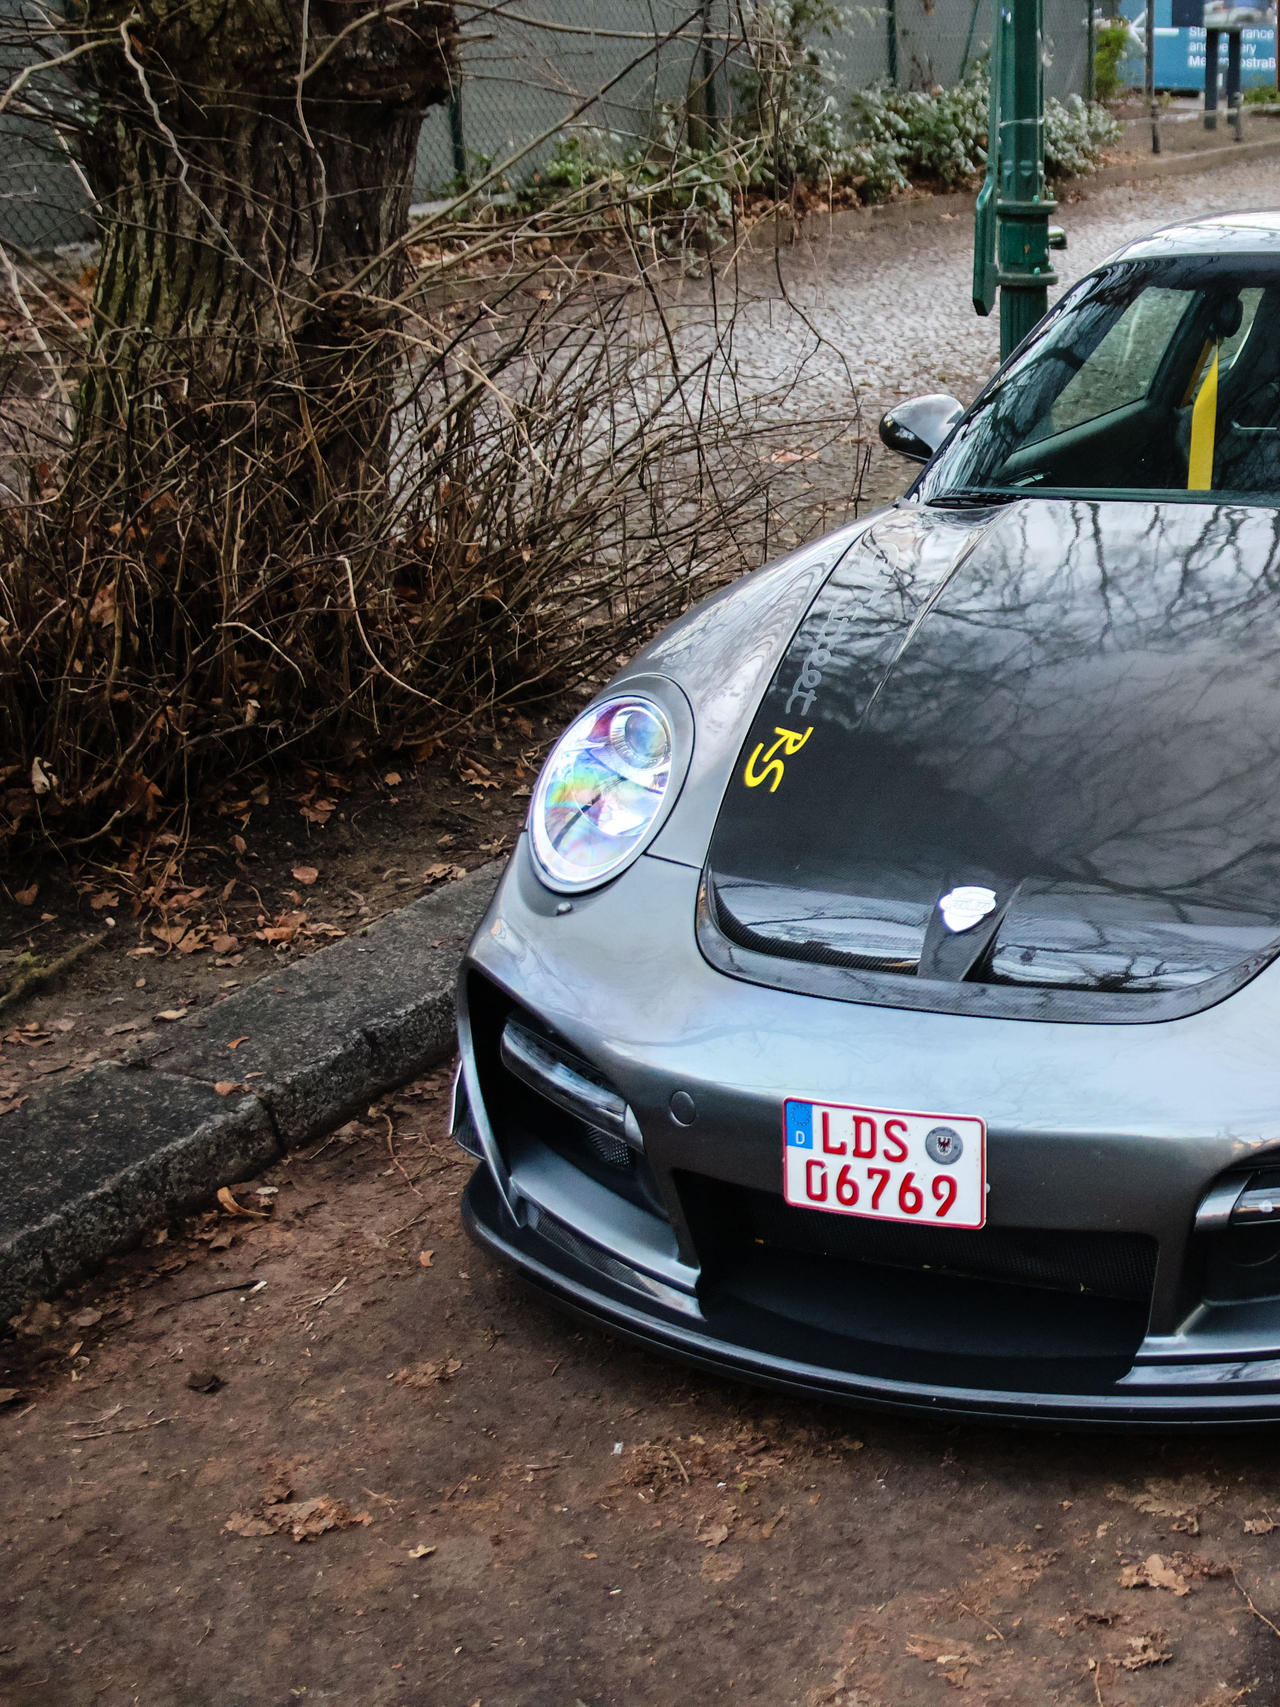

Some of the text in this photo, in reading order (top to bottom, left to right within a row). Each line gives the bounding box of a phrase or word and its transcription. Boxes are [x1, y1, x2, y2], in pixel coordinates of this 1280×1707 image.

[1189, 26, 1210, 37] Sta
[744, 727, 814, 792] RS
[795, 1131, 805, 1144] D
[822, 1111, 908, 1162] LDS
[806, 1158, 957, 1217] 06769
